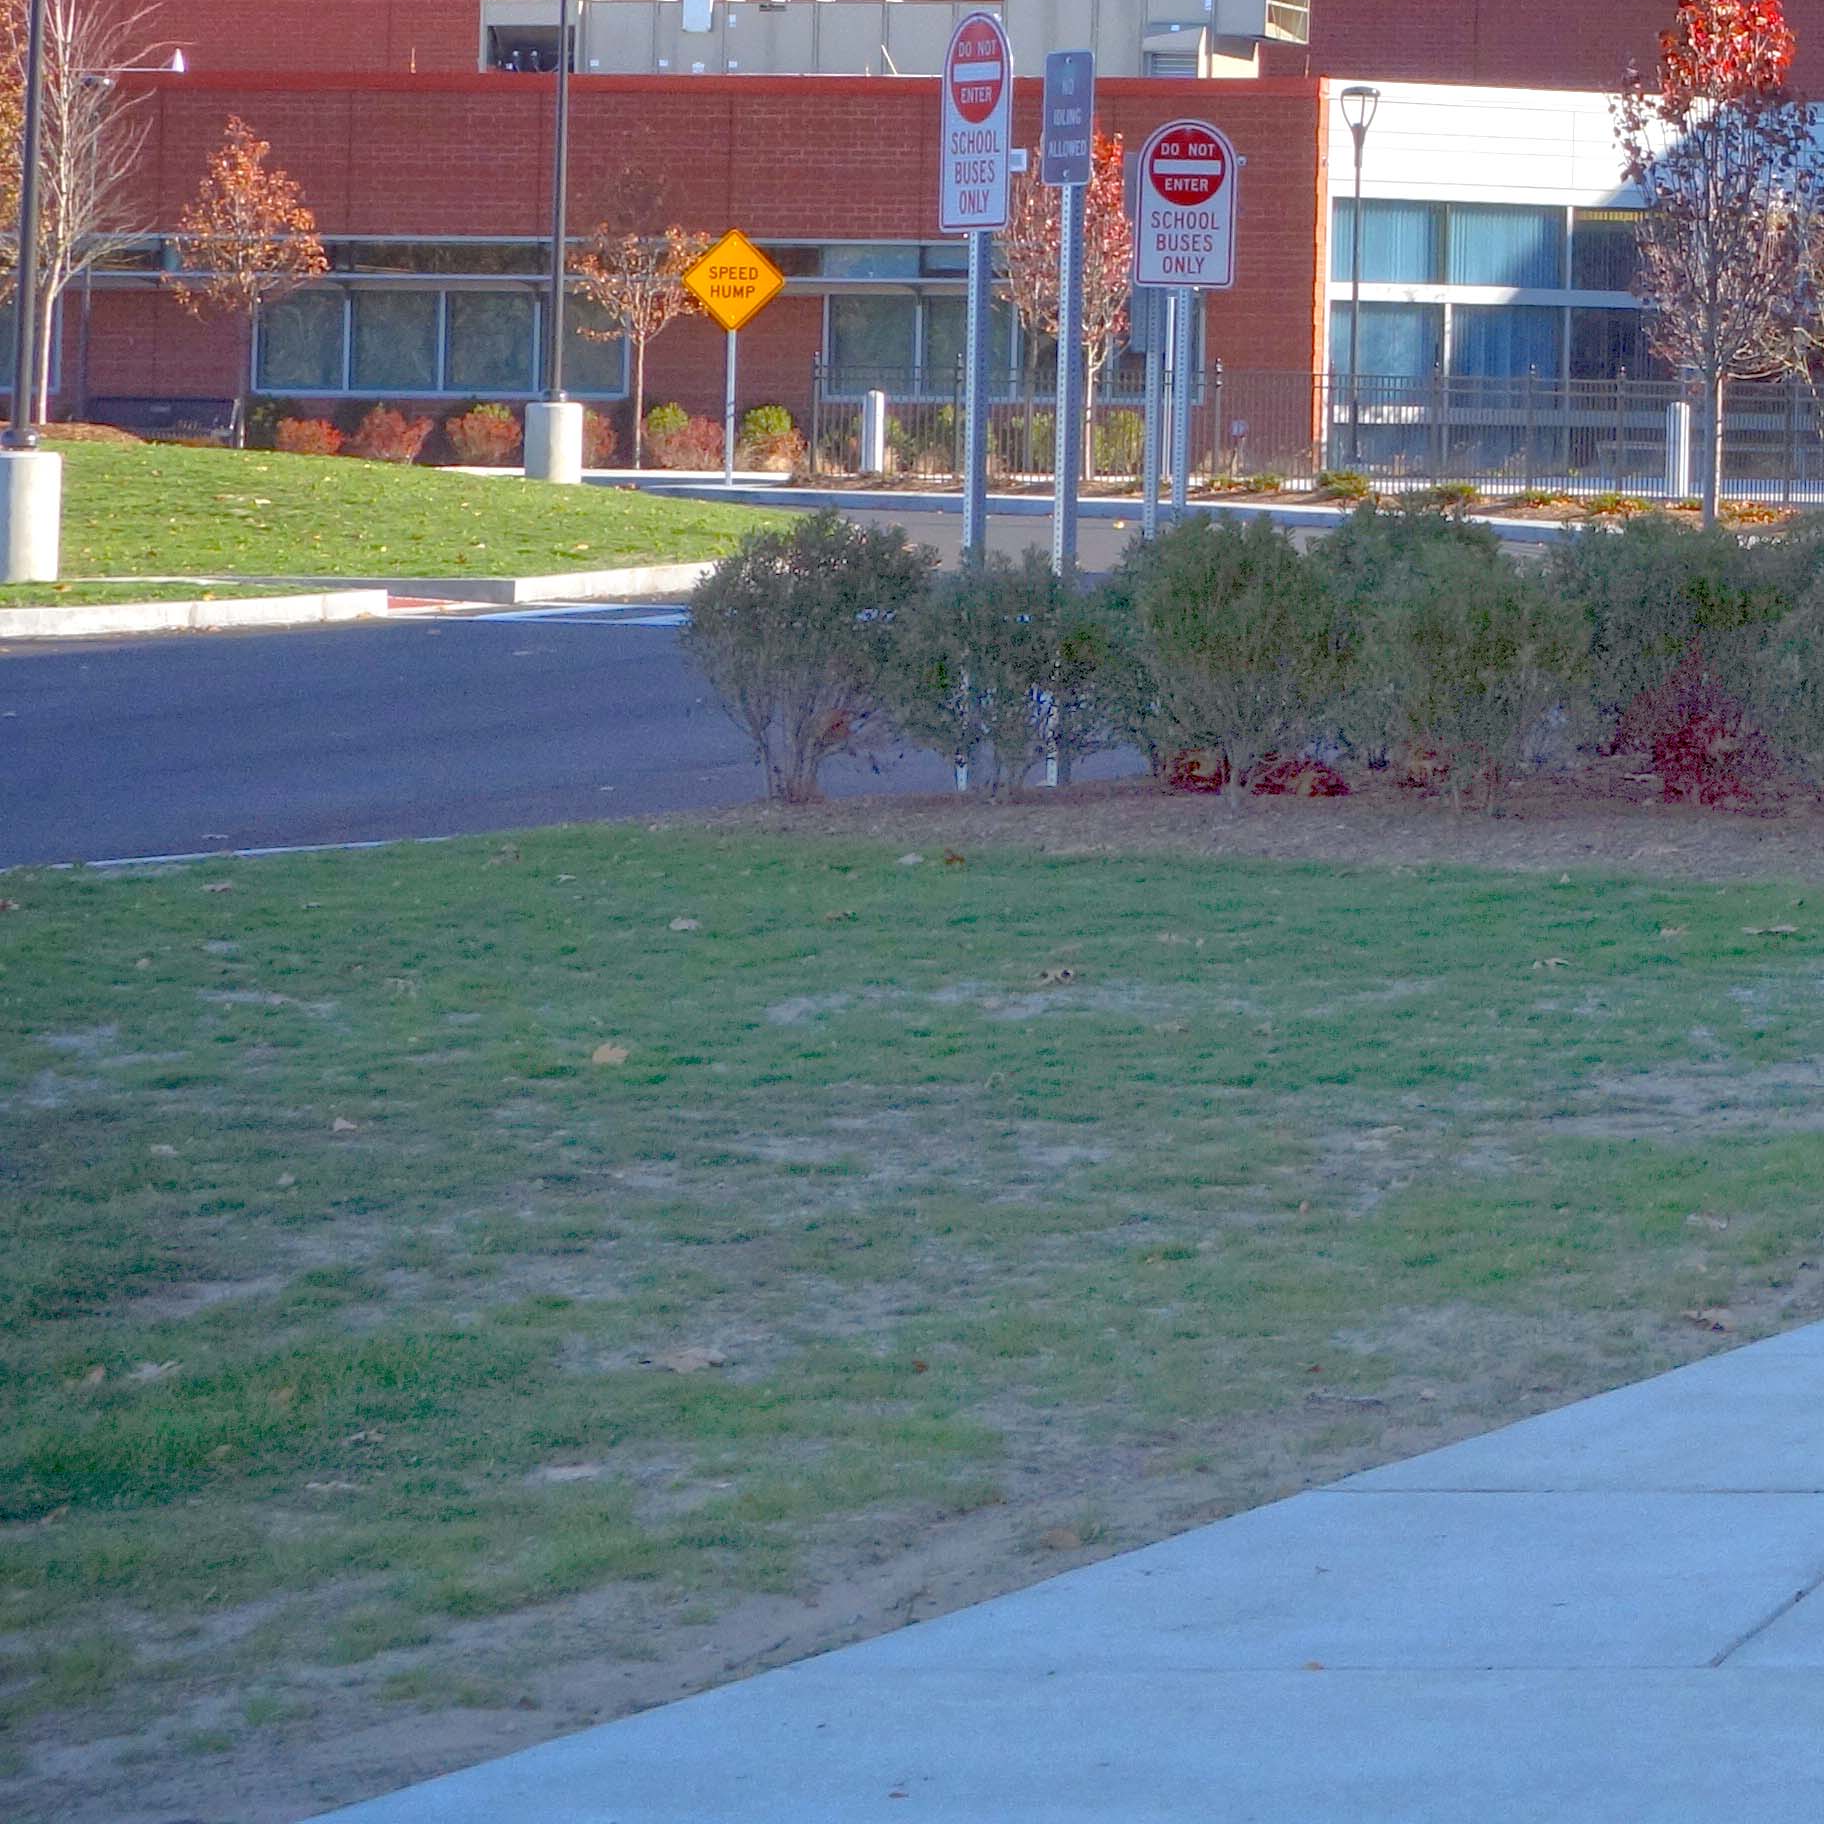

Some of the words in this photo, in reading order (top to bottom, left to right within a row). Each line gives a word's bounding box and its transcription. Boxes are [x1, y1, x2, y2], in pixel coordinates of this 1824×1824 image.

[958, 41, 972, 57] DO
[977, 40, 997, 56] NOT
[960, 87, 993, 104] ENTER
[951, 130, 1000, 156] SCHOOL
[1048, 140, 1087, 159] ALLOWED
[1161, 143, 1180, 156] DO
[1188, 143, 1215, 157] NOT
[954, 160, 996, 185] BUSES
[1164, 178, 1209, 192] ENTER
[959, 190, 990, 216] ONLY
[1151, 210, 1220, 230] SCHOOL
[1156, 233, 1213, 253] BUSES
[708, 266, 759, 281] SPEED
[1162, 255, 1206, 274] ONLY
[710, 284, 756, 299] HUMP
